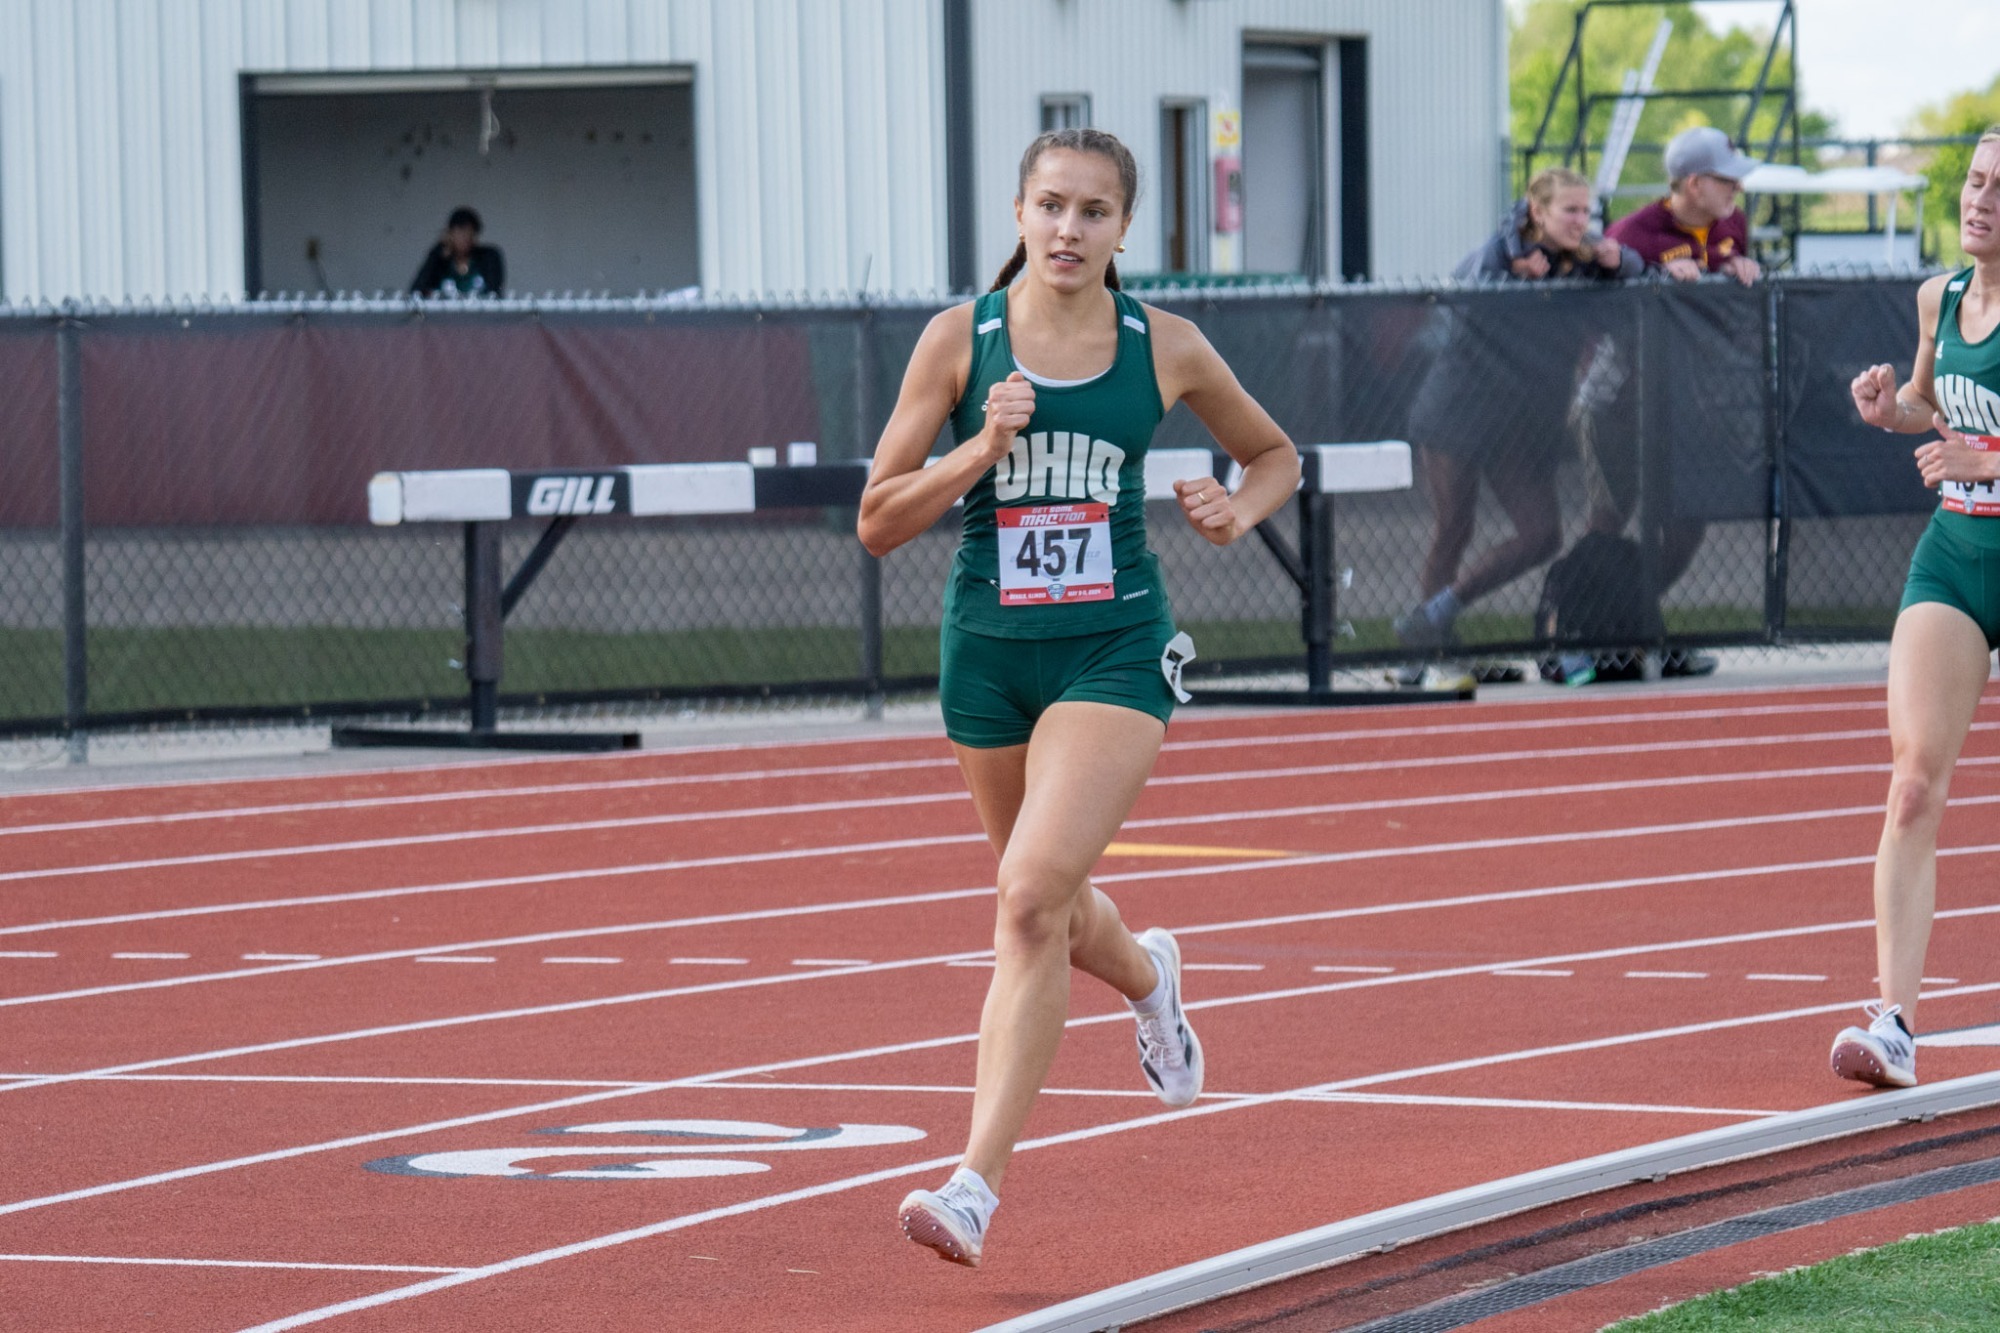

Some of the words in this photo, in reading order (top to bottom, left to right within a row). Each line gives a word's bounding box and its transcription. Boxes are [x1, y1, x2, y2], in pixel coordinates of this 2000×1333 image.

[995, 431, 1126, 507] OHIO
[527, 476, 616, 516] GILL
[1032, 507, 1048, 515] GET
[1049, 505, 1073, 513] SOME
[1016, 527, 1092, 577] 457
